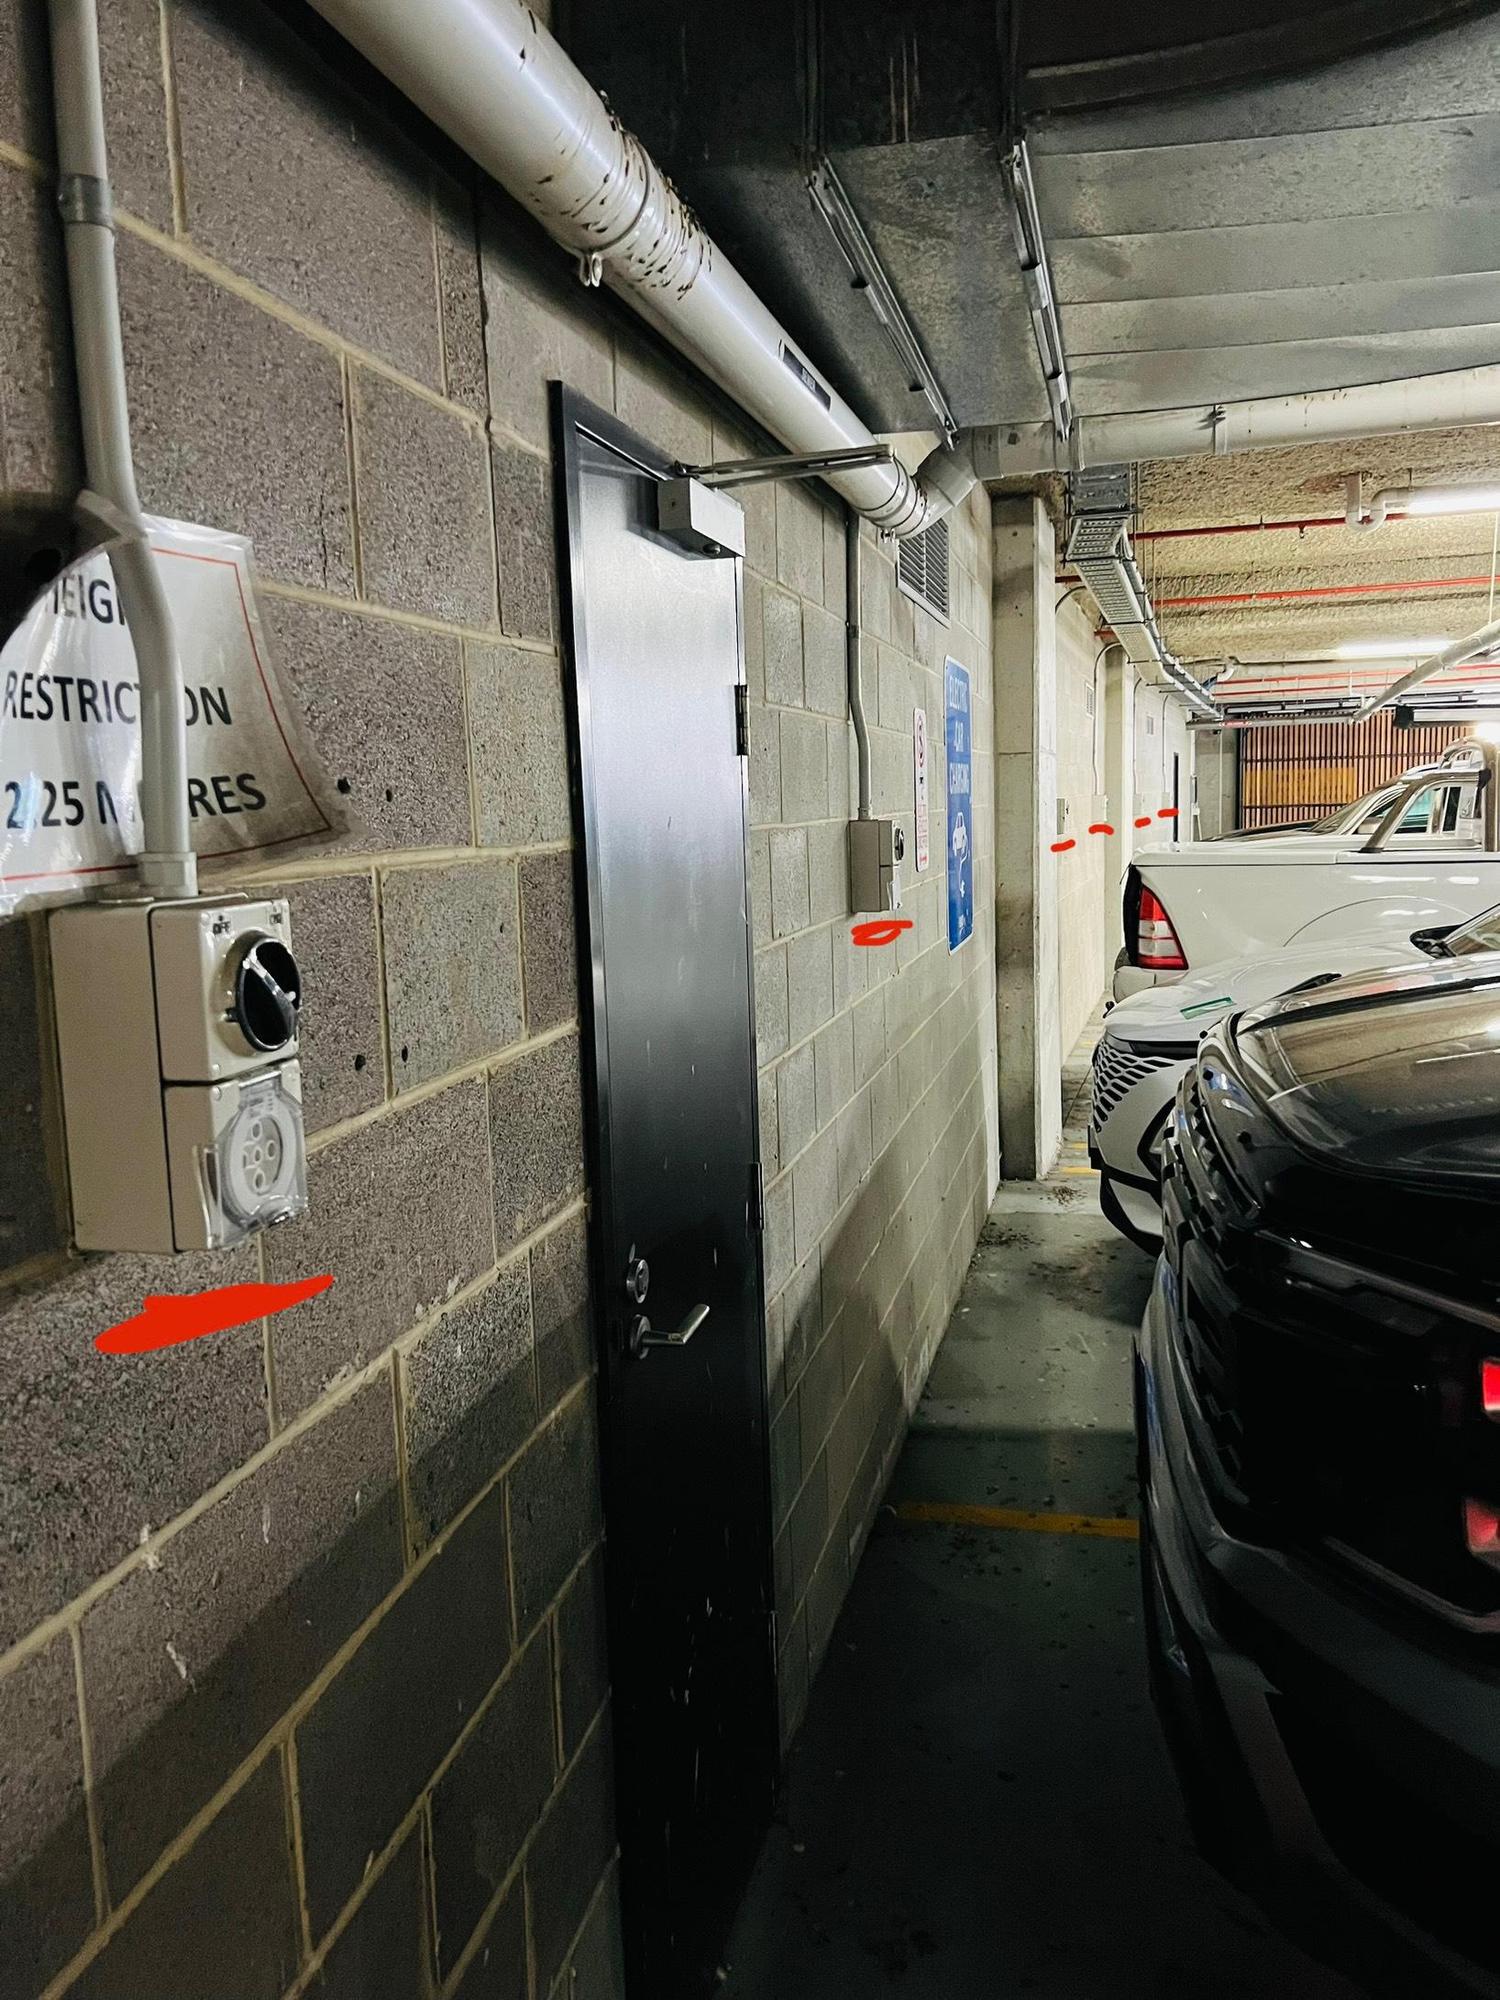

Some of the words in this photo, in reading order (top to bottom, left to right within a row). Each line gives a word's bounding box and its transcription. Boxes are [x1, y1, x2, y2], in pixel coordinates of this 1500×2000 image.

[45, 574, 125, 627] EIG
[4, 670, 232, 727] RESTRICN
[96, 773, 267, 824] MRES
